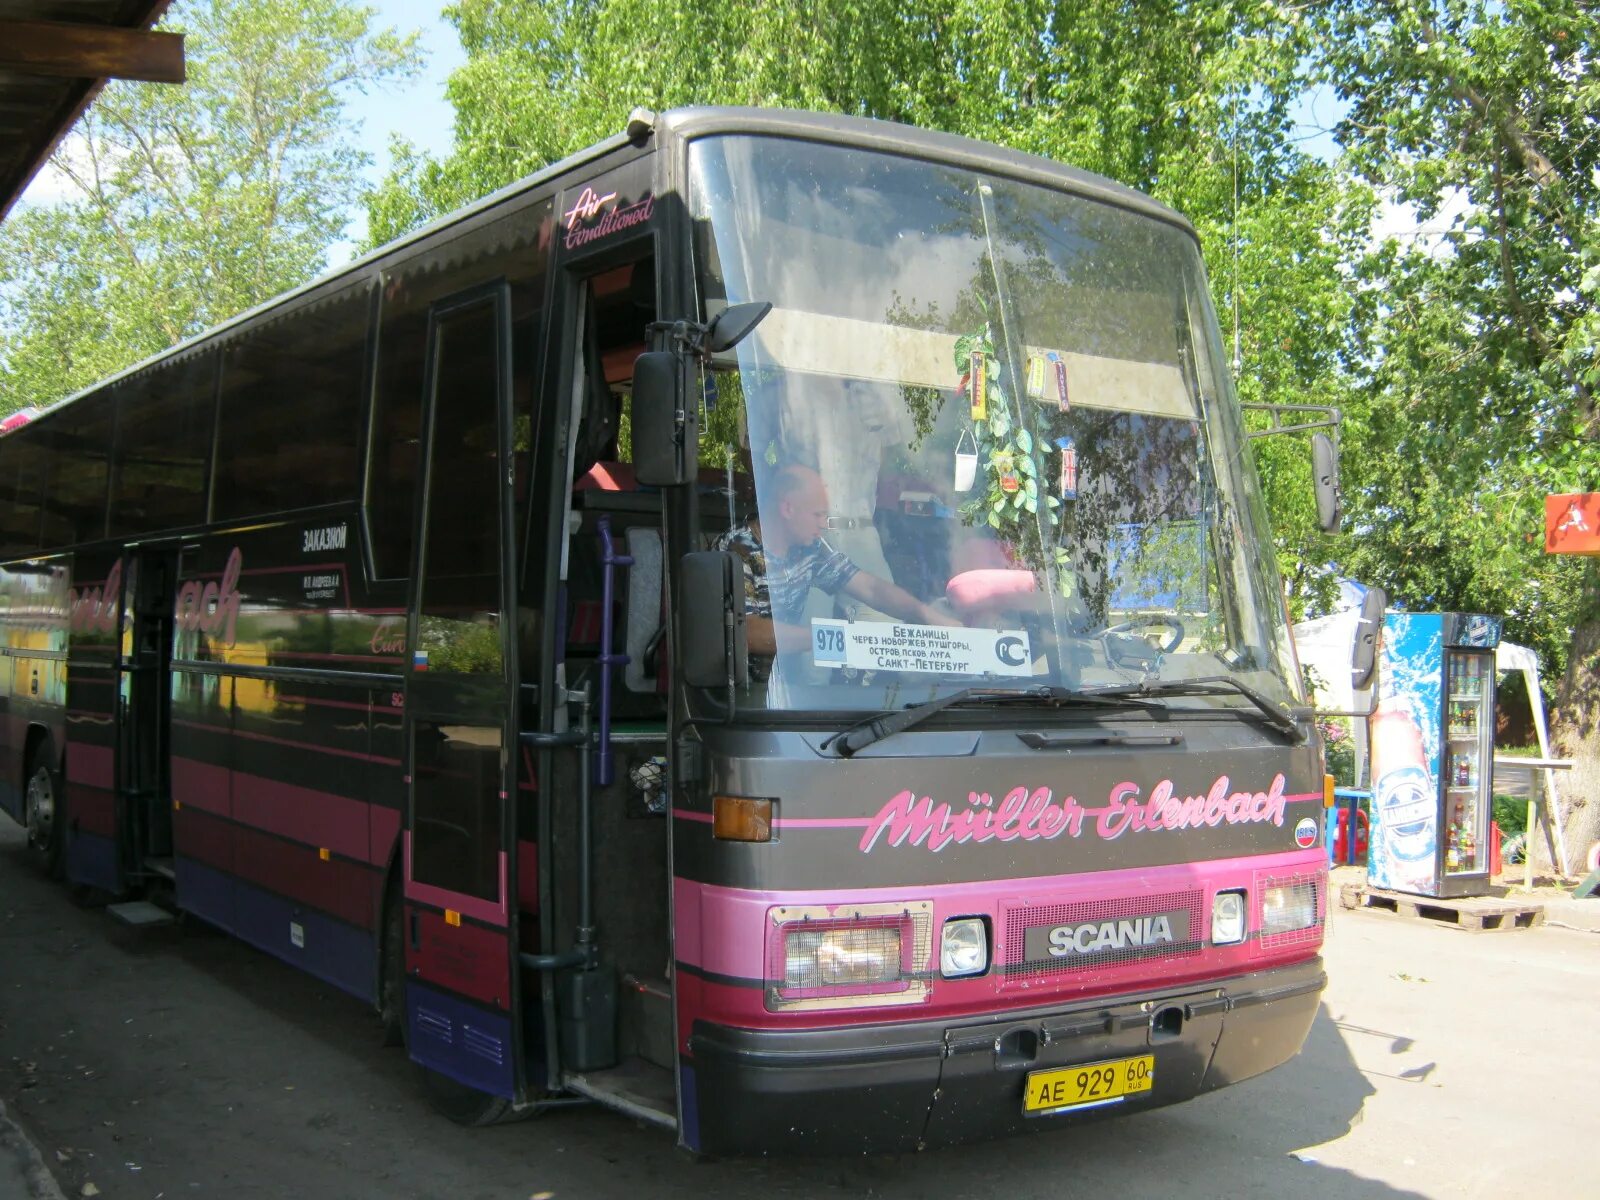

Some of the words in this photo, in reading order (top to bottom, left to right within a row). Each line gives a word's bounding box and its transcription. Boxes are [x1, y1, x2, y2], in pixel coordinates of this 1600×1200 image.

[565, 187, 616, 229] Air
[302, 521, 347, 552] ЗАКАЗНОЙ
[816, 628, 845, 652] 978
[852, 635, 878, 644] ЧЕРЕЗ
[929, 650, 951, 659] ЛУГА
[859, 785, 1086, 853] Müller
[1096, 773, 1287, 840] Erlenbach
[1048, 915, 1172, 957] SCANIA
[1076, 1067, 1115, 1098] 929
[1127, 1060, 1146, 1081] 60
[1128, 1081, 1142, 1090] RUS
